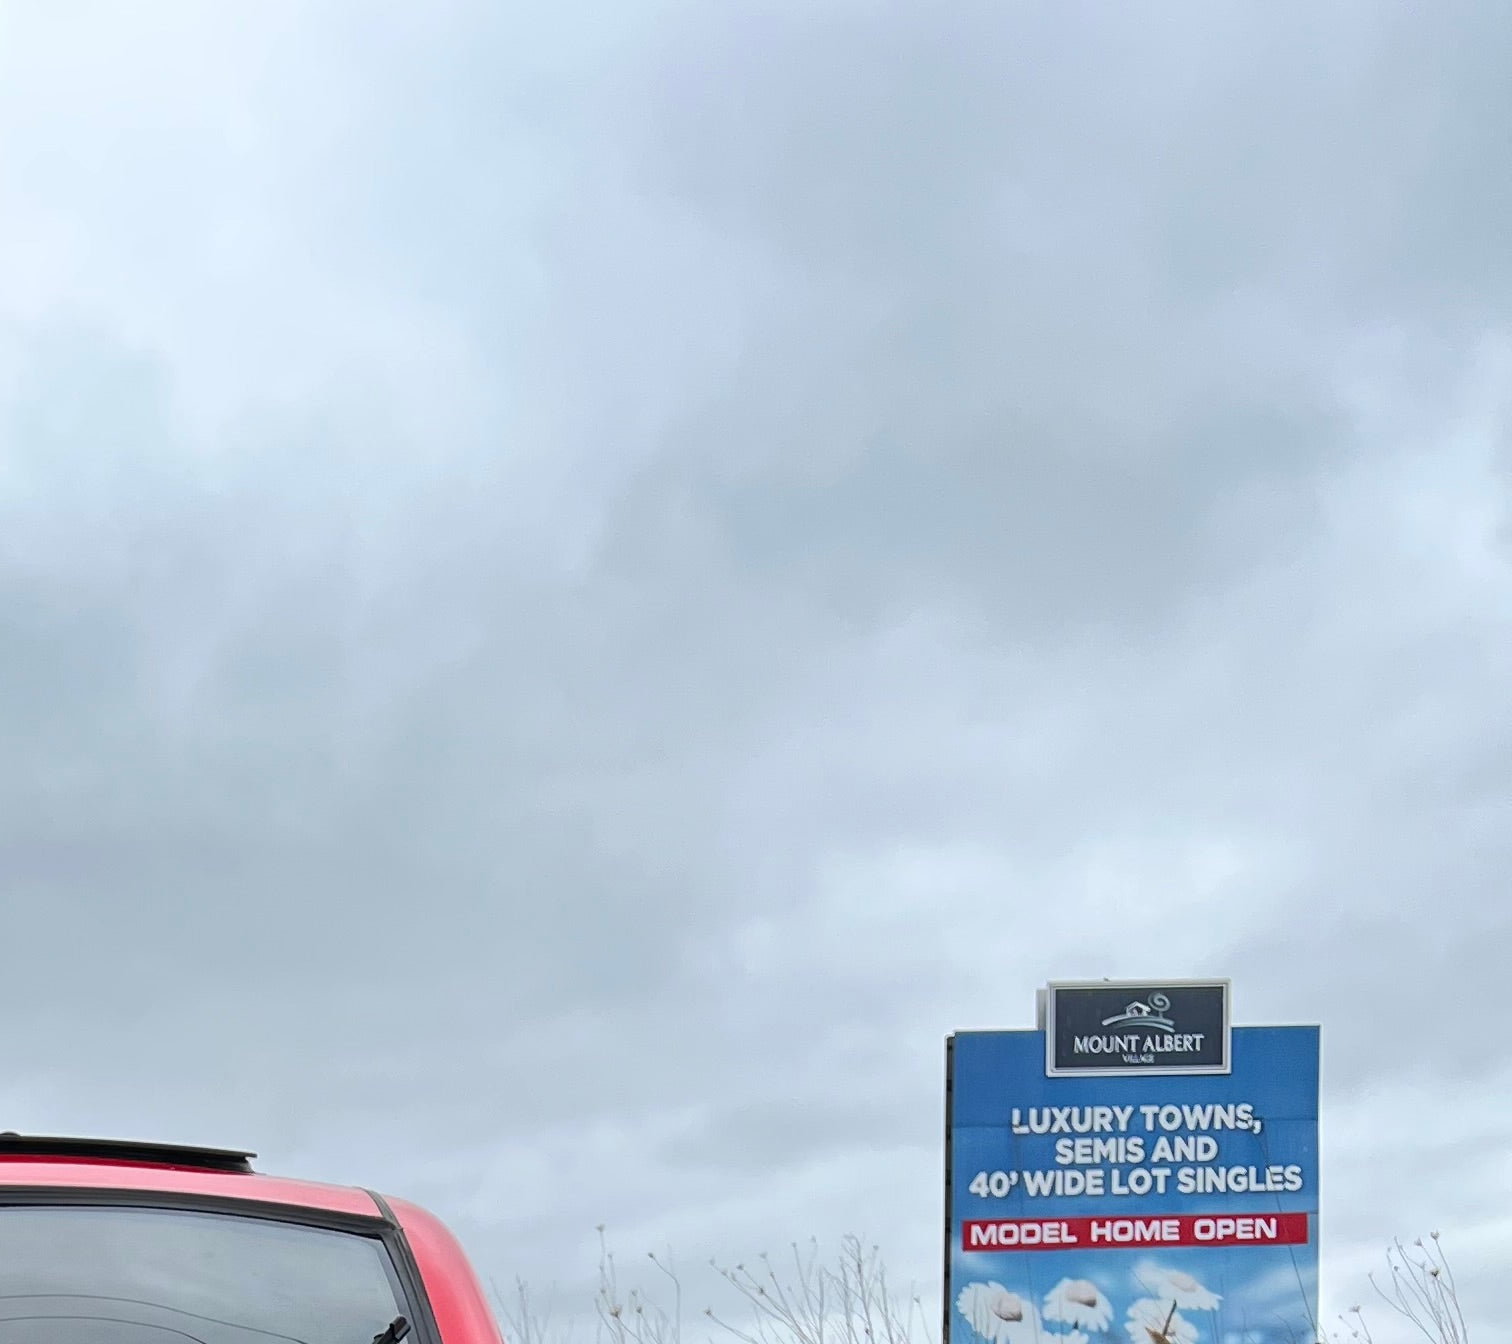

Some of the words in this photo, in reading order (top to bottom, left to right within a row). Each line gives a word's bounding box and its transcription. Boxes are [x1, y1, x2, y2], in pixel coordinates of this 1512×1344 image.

[1073, 1034, 1140, 1054] MOUNT
[1142, 1033, 1205, 1052] ALBERT
[1011, 1104, 1134, 1135] LUXURY
[1139, 1103, 1263, 1135] TOWNS,
[1054, 1137, 1145, 1166] SEMIS
[1151, 1135, 1219, 1163] AND
[1022, 1168, 1105, 1197] WIDE
[1110, 1167, 1172, 1196] LOT
[1177, 1164, 1303, 1194] SINGLES
[970, 1221, 1078, 1246] MODEL
[1090, 1219, 1181, 1243] HOME
[1193, 1218, 1278, 1241] OPEN
